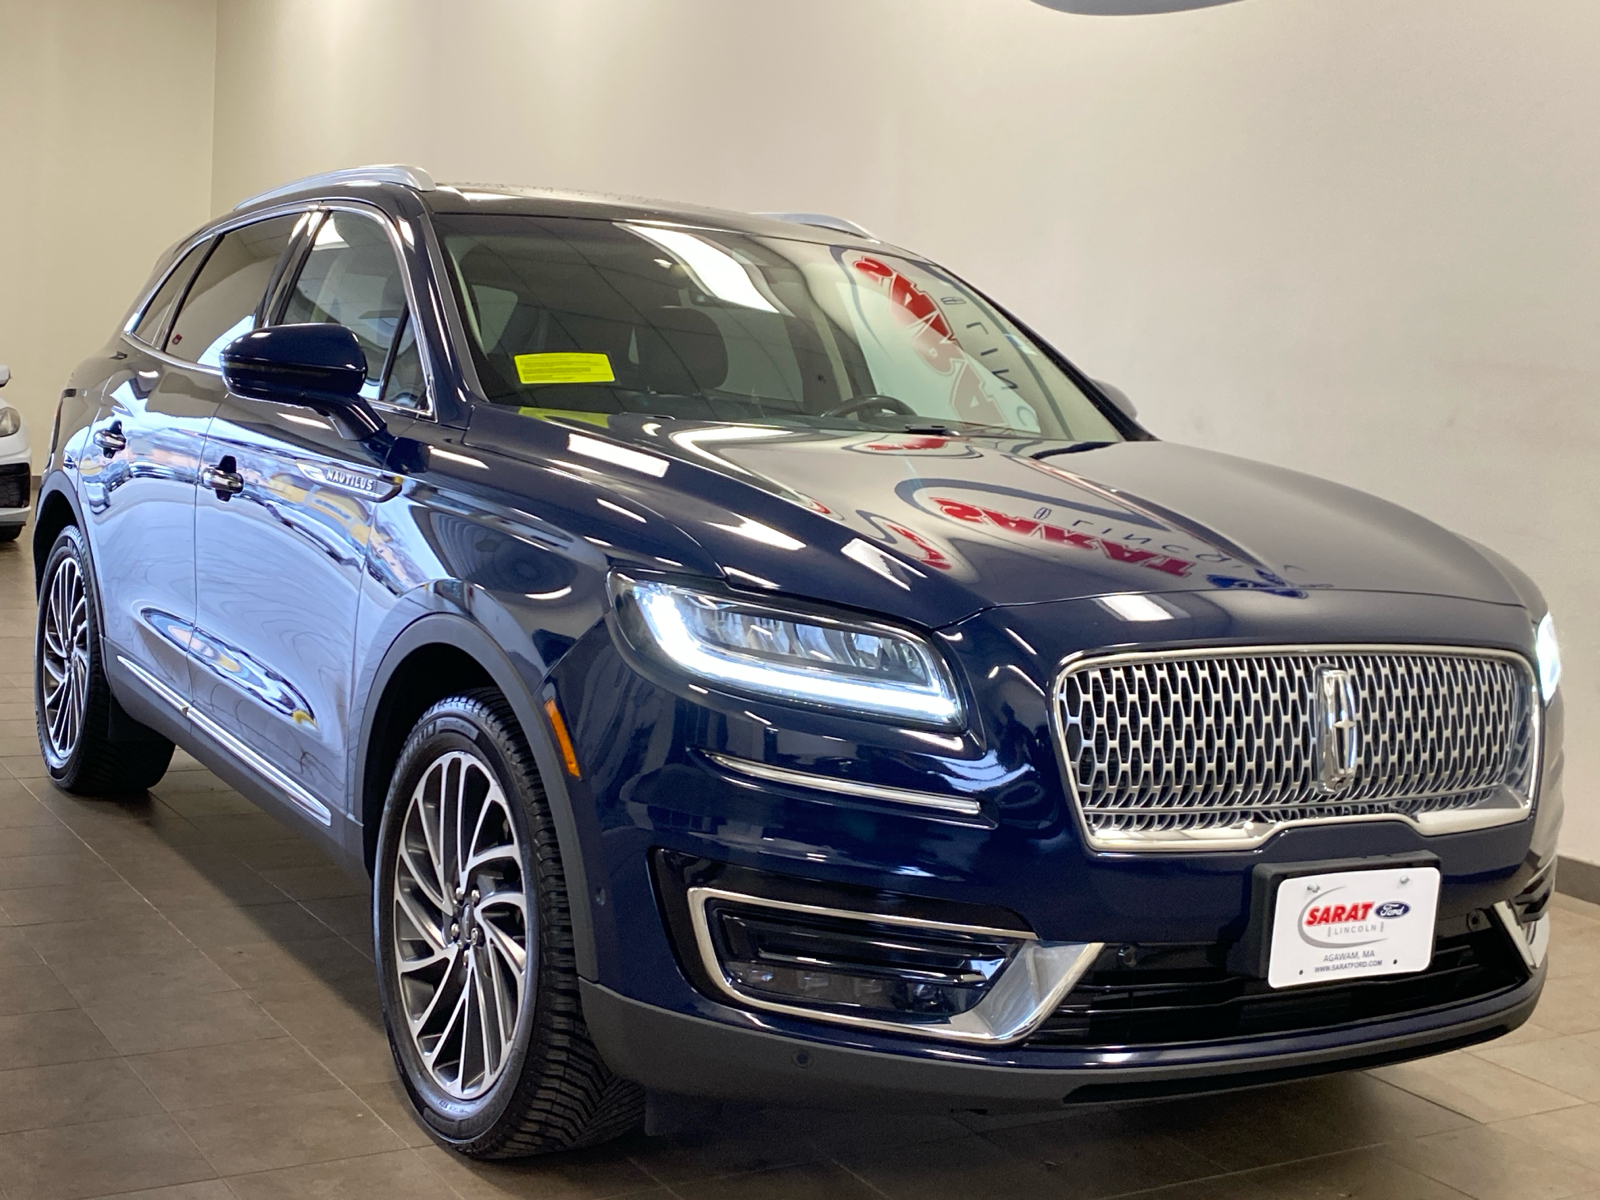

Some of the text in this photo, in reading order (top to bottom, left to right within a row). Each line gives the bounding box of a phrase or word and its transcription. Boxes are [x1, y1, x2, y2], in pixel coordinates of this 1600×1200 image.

[326, 469, 374, 490] NAUTILUS
[1305, 901, 1406, 926] SARAT Ford
[1334, 924, 1377, 935] LINCOLN
[1323, 950, 1375, 962] AGAWAM, MA
[1314, 959, 1383, 973] WWW.SARATFORD.COM
